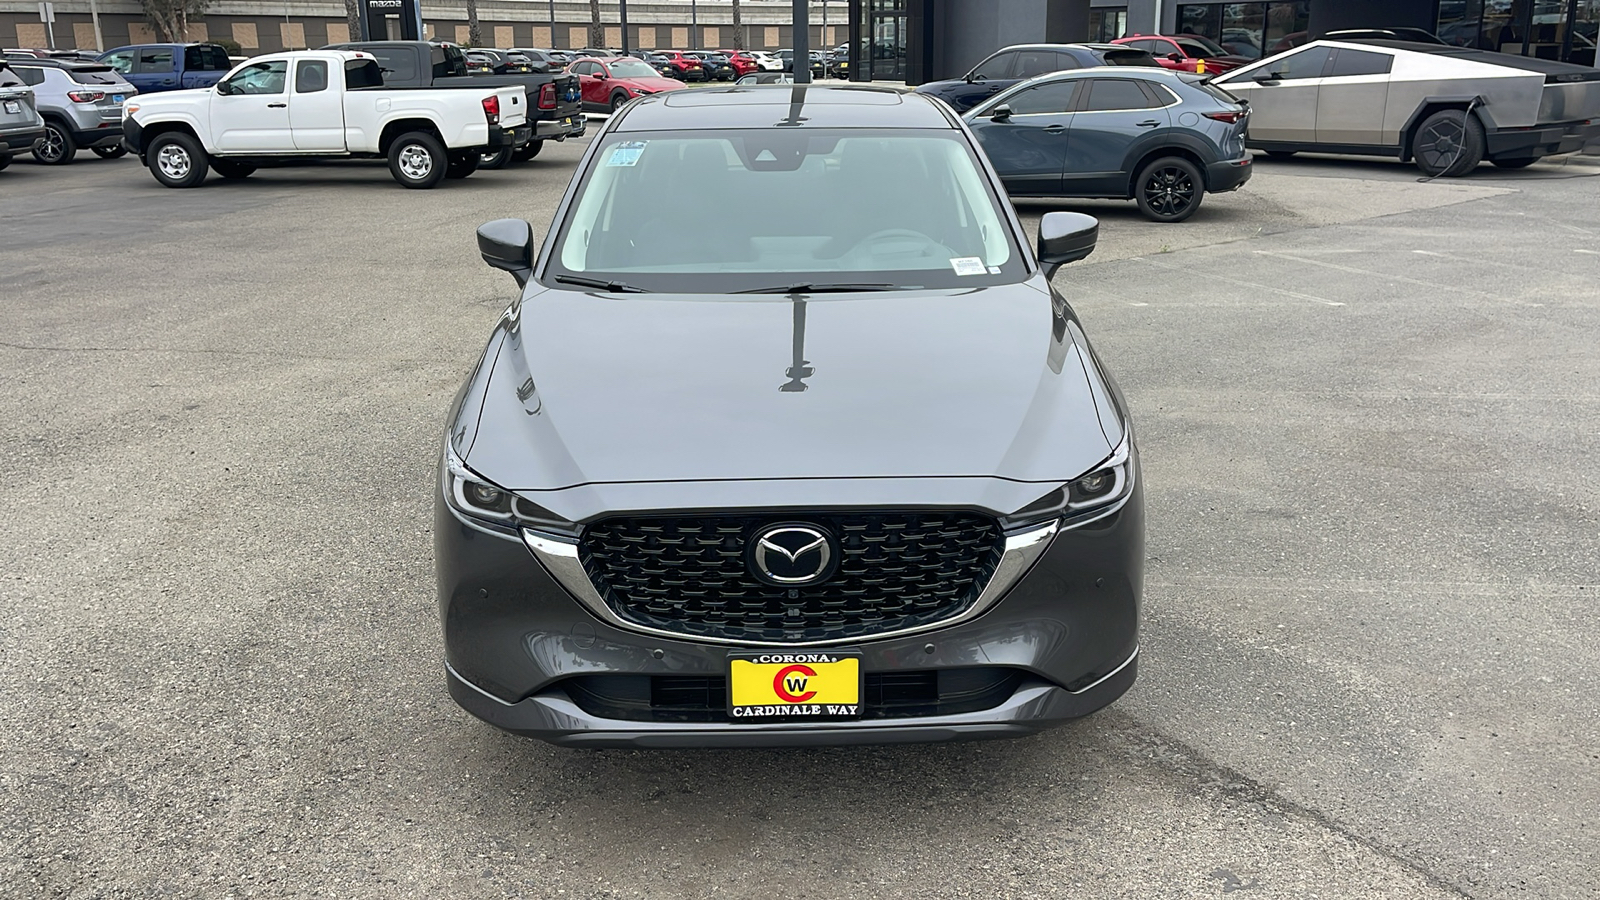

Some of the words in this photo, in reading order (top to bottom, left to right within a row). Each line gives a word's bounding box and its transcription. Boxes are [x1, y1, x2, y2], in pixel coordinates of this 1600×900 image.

[759, 654, 830, 663] CORONA
[733, 705, 821, 717] CARDINALE
[826, 705, 858, 715] WAY
